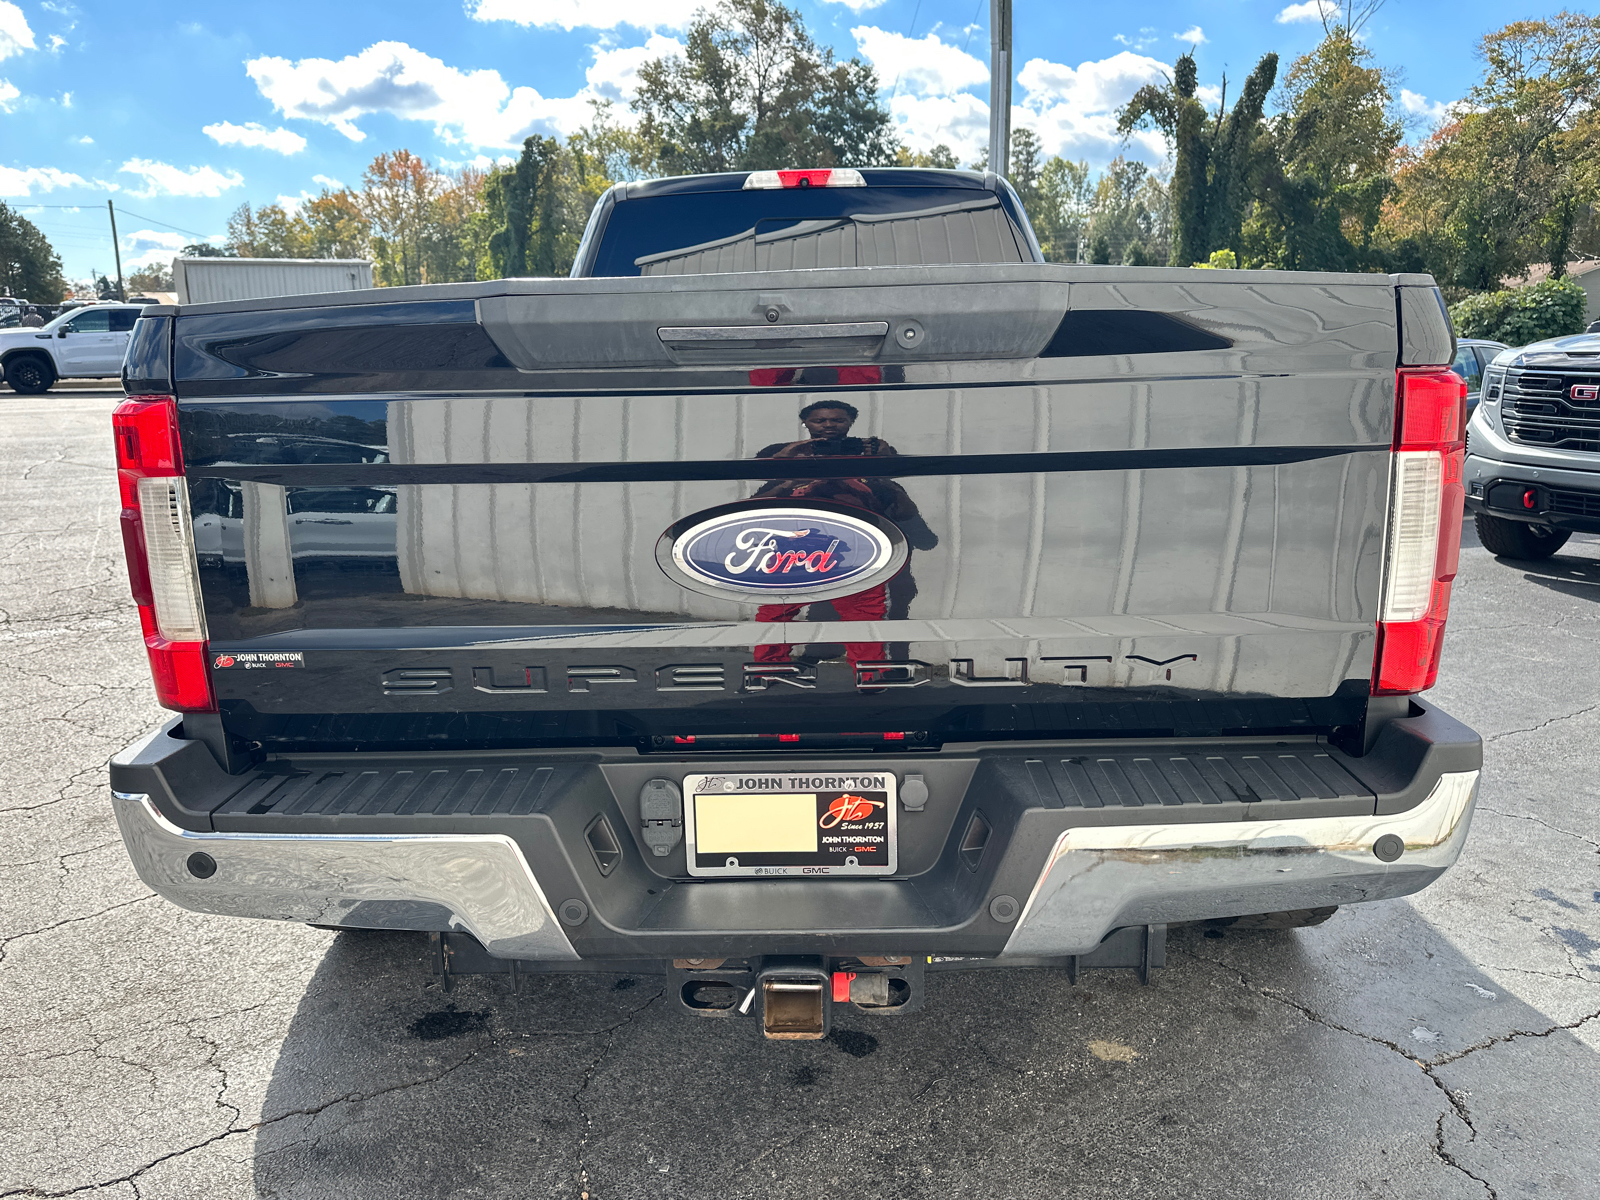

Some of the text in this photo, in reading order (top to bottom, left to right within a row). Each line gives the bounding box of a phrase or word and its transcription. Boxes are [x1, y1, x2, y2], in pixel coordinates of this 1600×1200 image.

[724, 527, 840, 574] Ford
[236, 653, 258, 661] JOHN
[259, 653, 301, 661] THORNTON
[382, 653, 1198, 696] SUPER DUTY
[736, 777, 783, 790] JOHN
[788, 776, 886, 790] THORNTON
[840, 822, 885, 830] Since 1957
[821, 836, 842, 844] JOHN
[764, 867, 788, 875] BUICK
